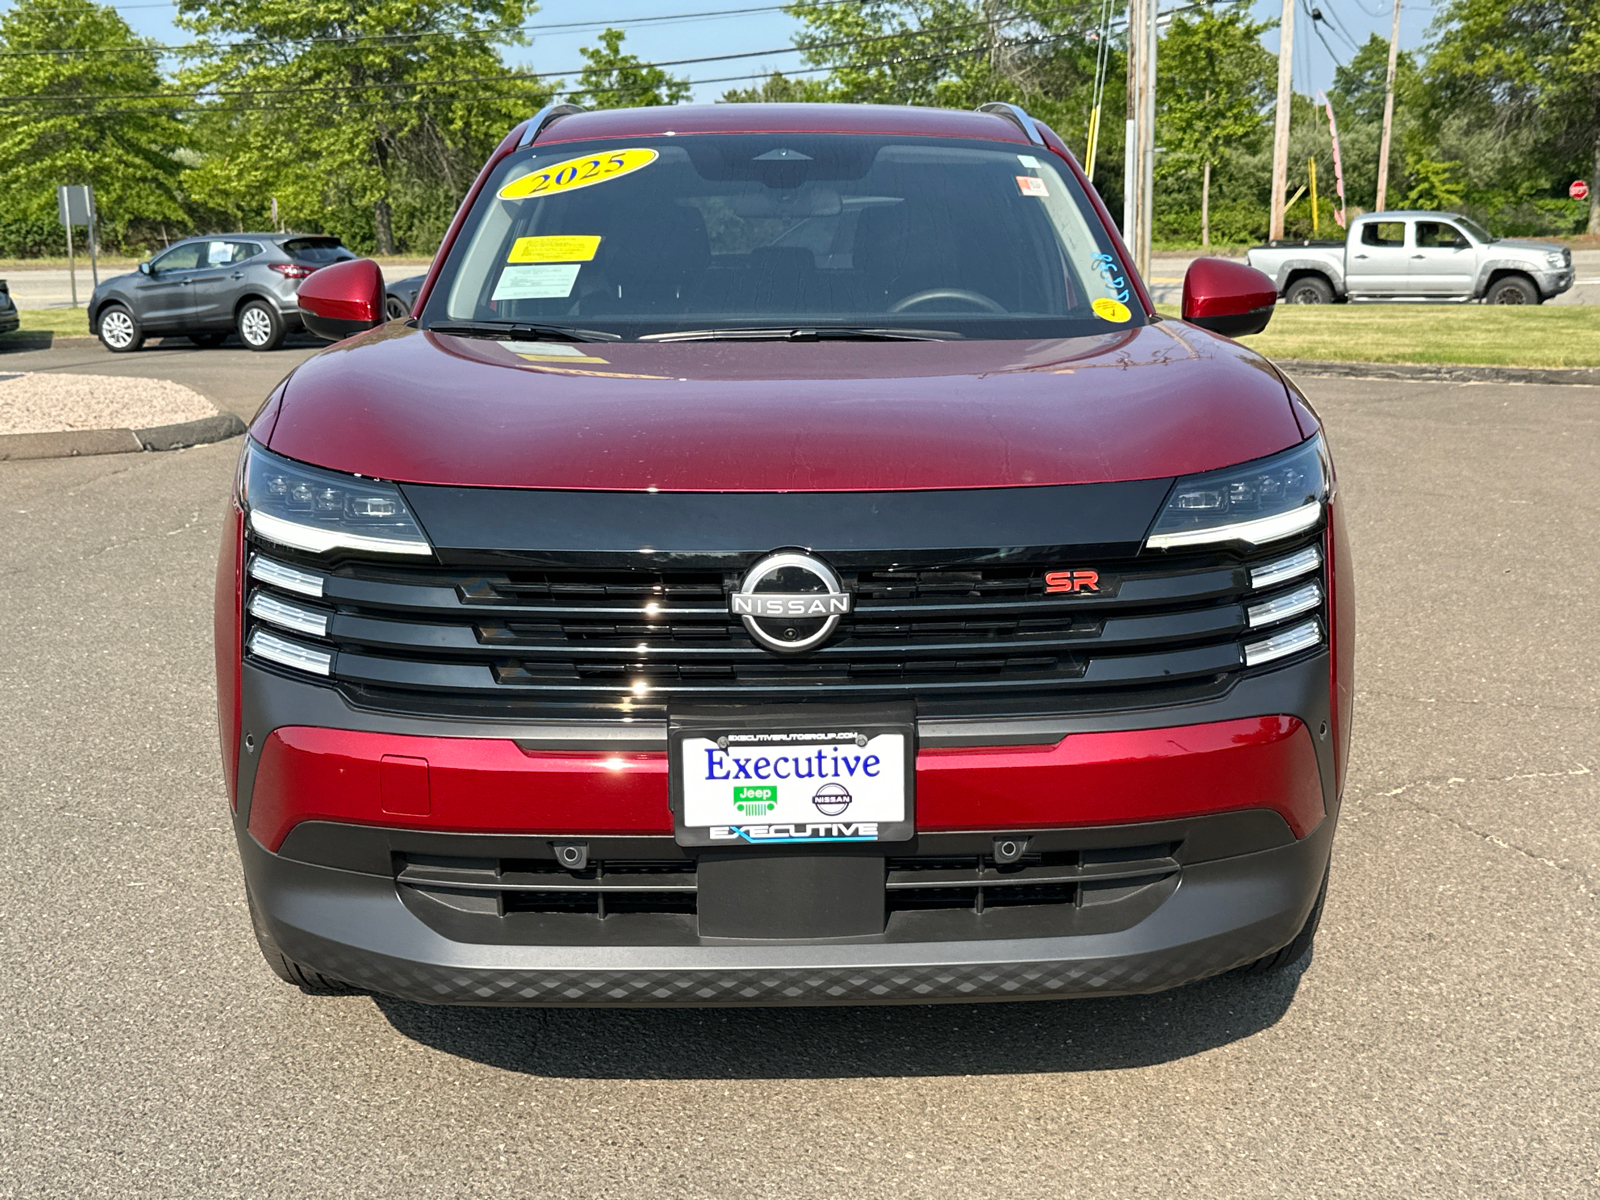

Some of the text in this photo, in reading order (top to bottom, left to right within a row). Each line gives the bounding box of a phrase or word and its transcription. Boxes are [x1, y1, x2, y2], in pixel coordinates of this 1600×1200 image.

[529, 152, 626, 194] 2025
[1045, 571, 1100, 593] SR
[735, 597, 848, 615] NISSAN
[704, 746, 881, 780] Executive
[739, 787, 772, 800] Jeep
[814, 796, 850, 804] NISSAN
[709, 823, 879, 840] EXECUTIVE
